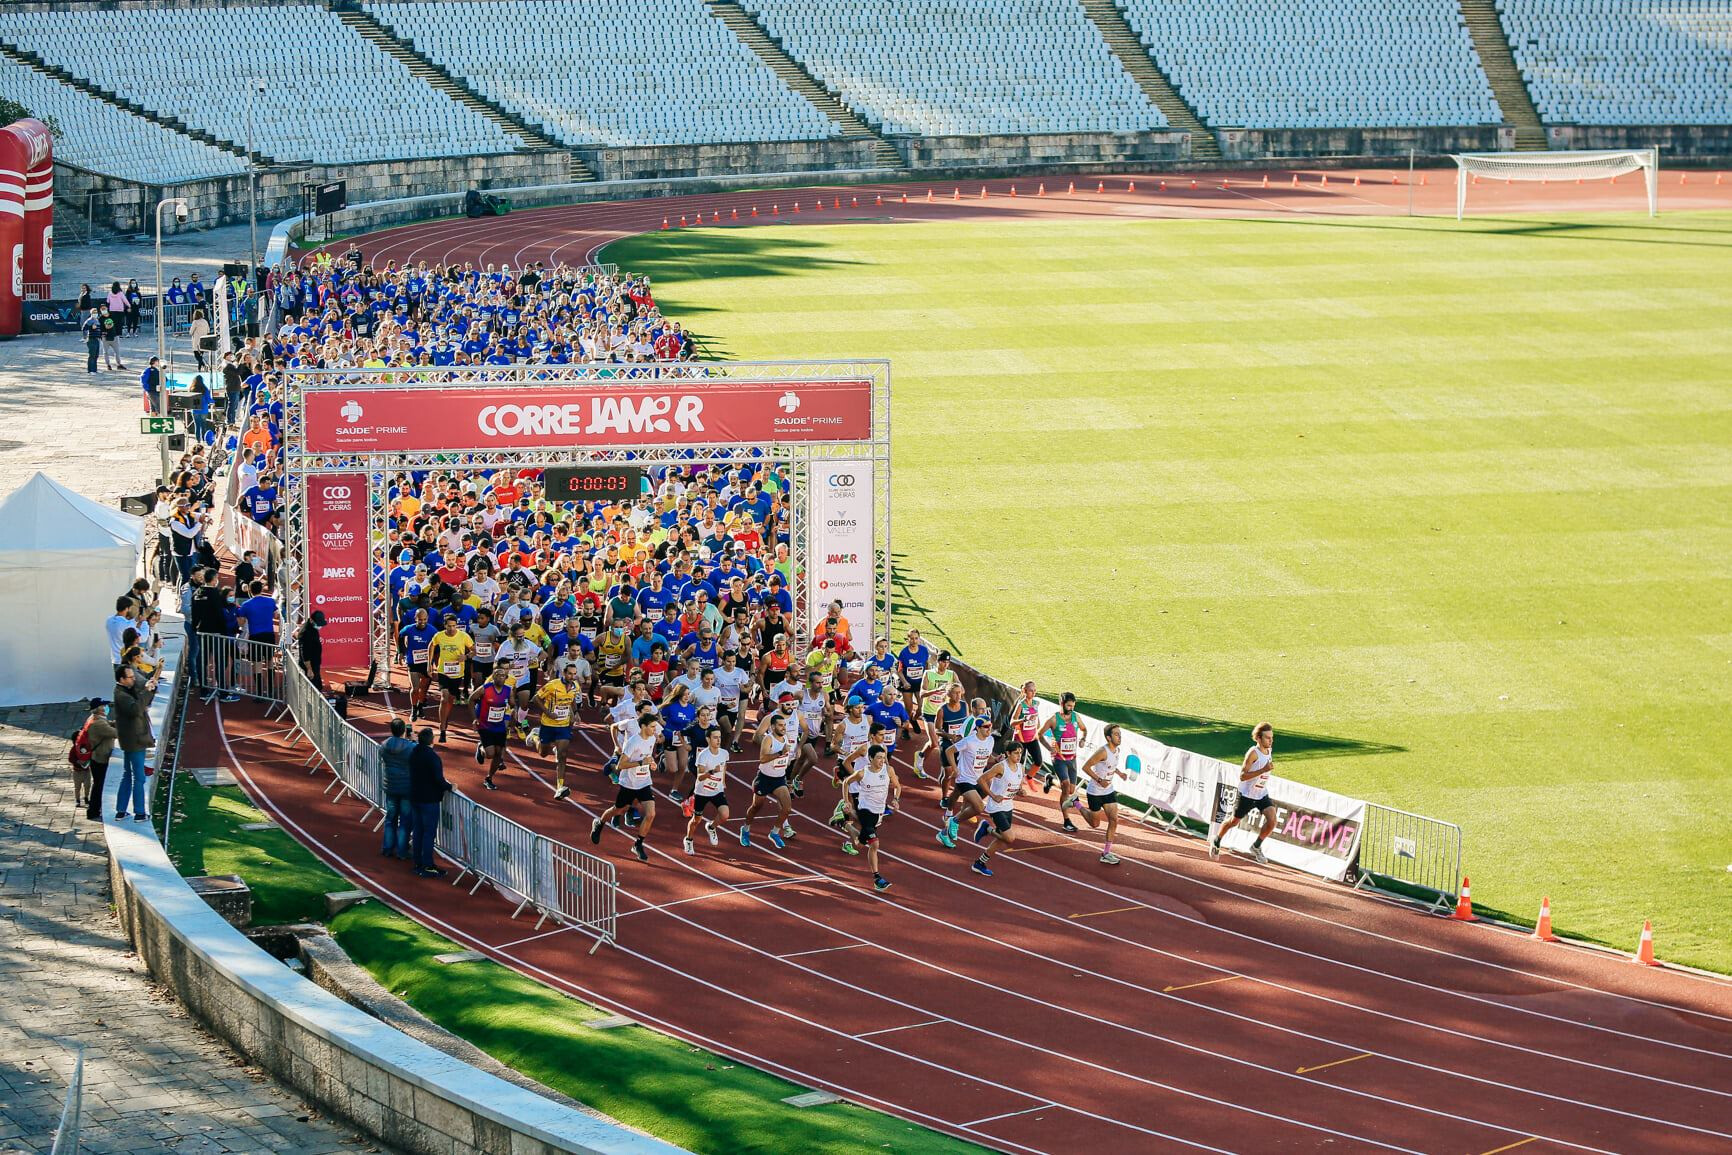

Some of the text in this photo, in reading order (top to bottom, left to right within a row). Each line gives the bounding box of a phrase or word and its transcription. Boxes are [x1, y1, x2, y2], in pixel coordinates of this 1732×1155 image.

[30, 313, 60, 321] OEIRAS
[478, 405, 580, 436] CORRE
[774, 416, 843, 425] SAÚDE PRIME
[335, 426, 407, 435] SAÚDE PRIME
[569, 476, 627, 491] 0:00:03
[830, 580, 864, 588] outsystems
[326, 594, 363, 603] outsystems
